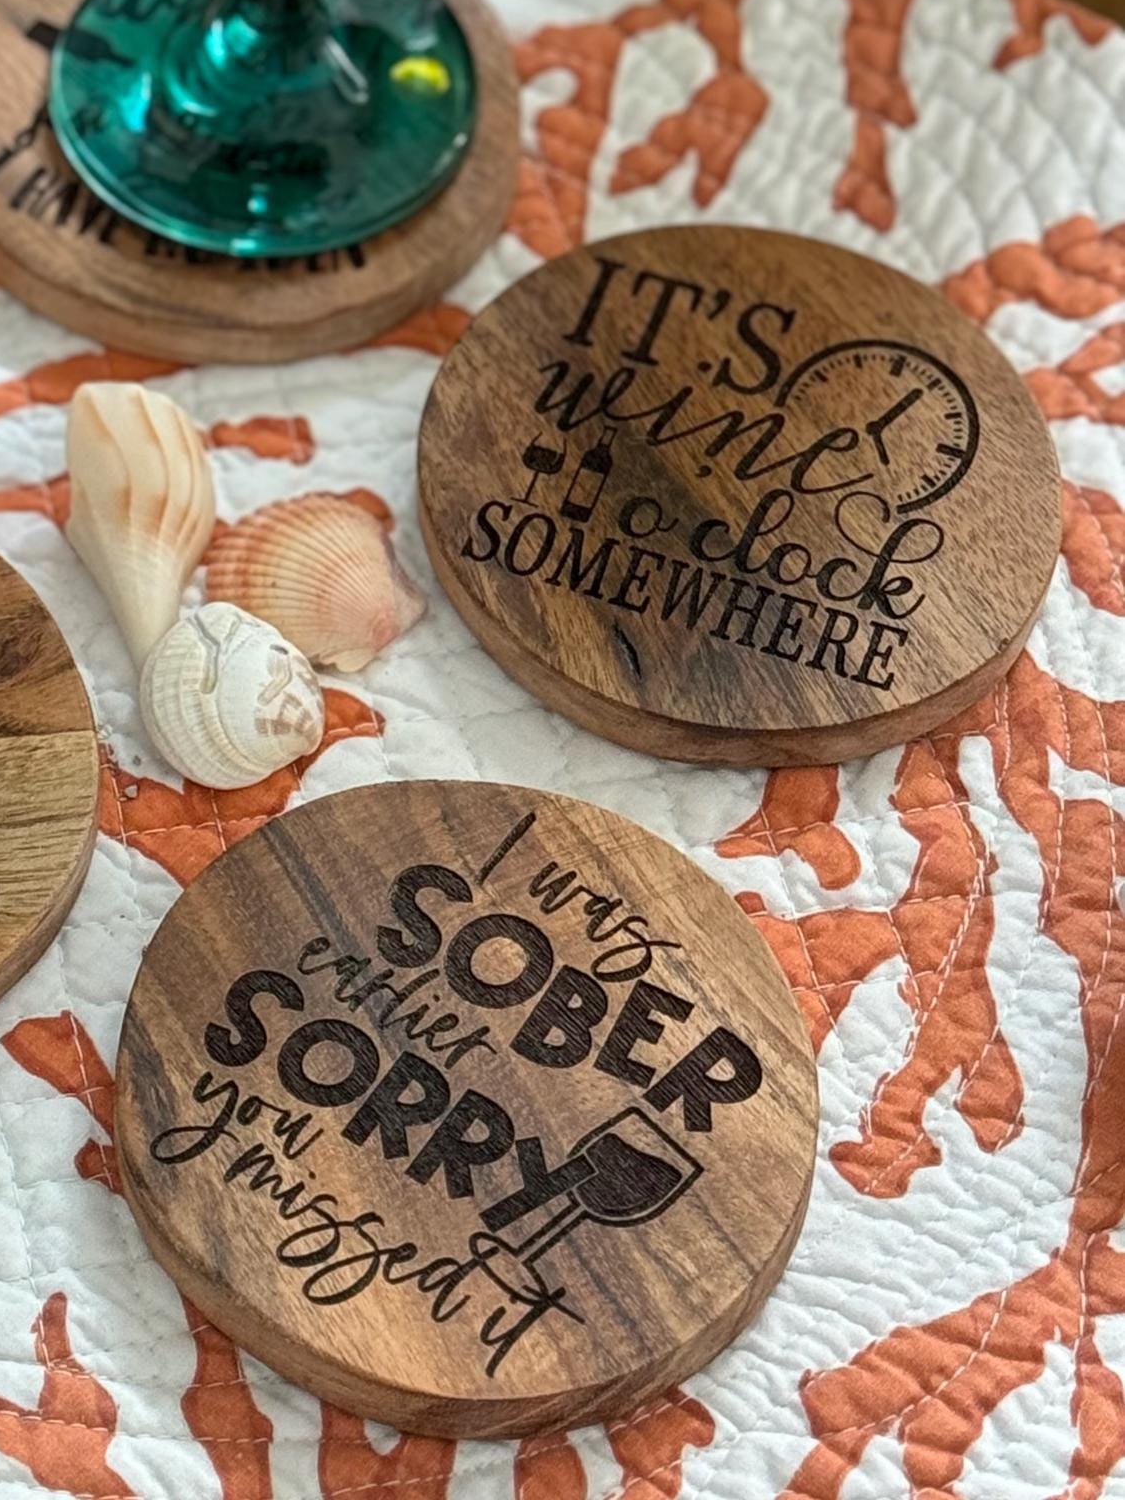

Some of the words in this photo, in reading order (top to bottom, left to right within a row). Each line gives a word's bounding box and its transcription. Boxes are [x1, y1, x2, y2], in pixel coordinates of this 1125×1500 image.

[562, 256, 796, 396] IT'S
[535, 347, 876, 495] wine
[460, 500, 908, 691] SOMEWHERE
[477, 812, 536, 885] I
[528, 861, 682, 982] was
[296, 935, 498, 1071] earlier
[377, 864, 763, 1133] SOBER
[150, 1071, 324, 1166] you
[204, 969, 597, 1232] SORRY
[224, 1143, 500, 1324] missed
[480, 1280, 585, 1377] it
